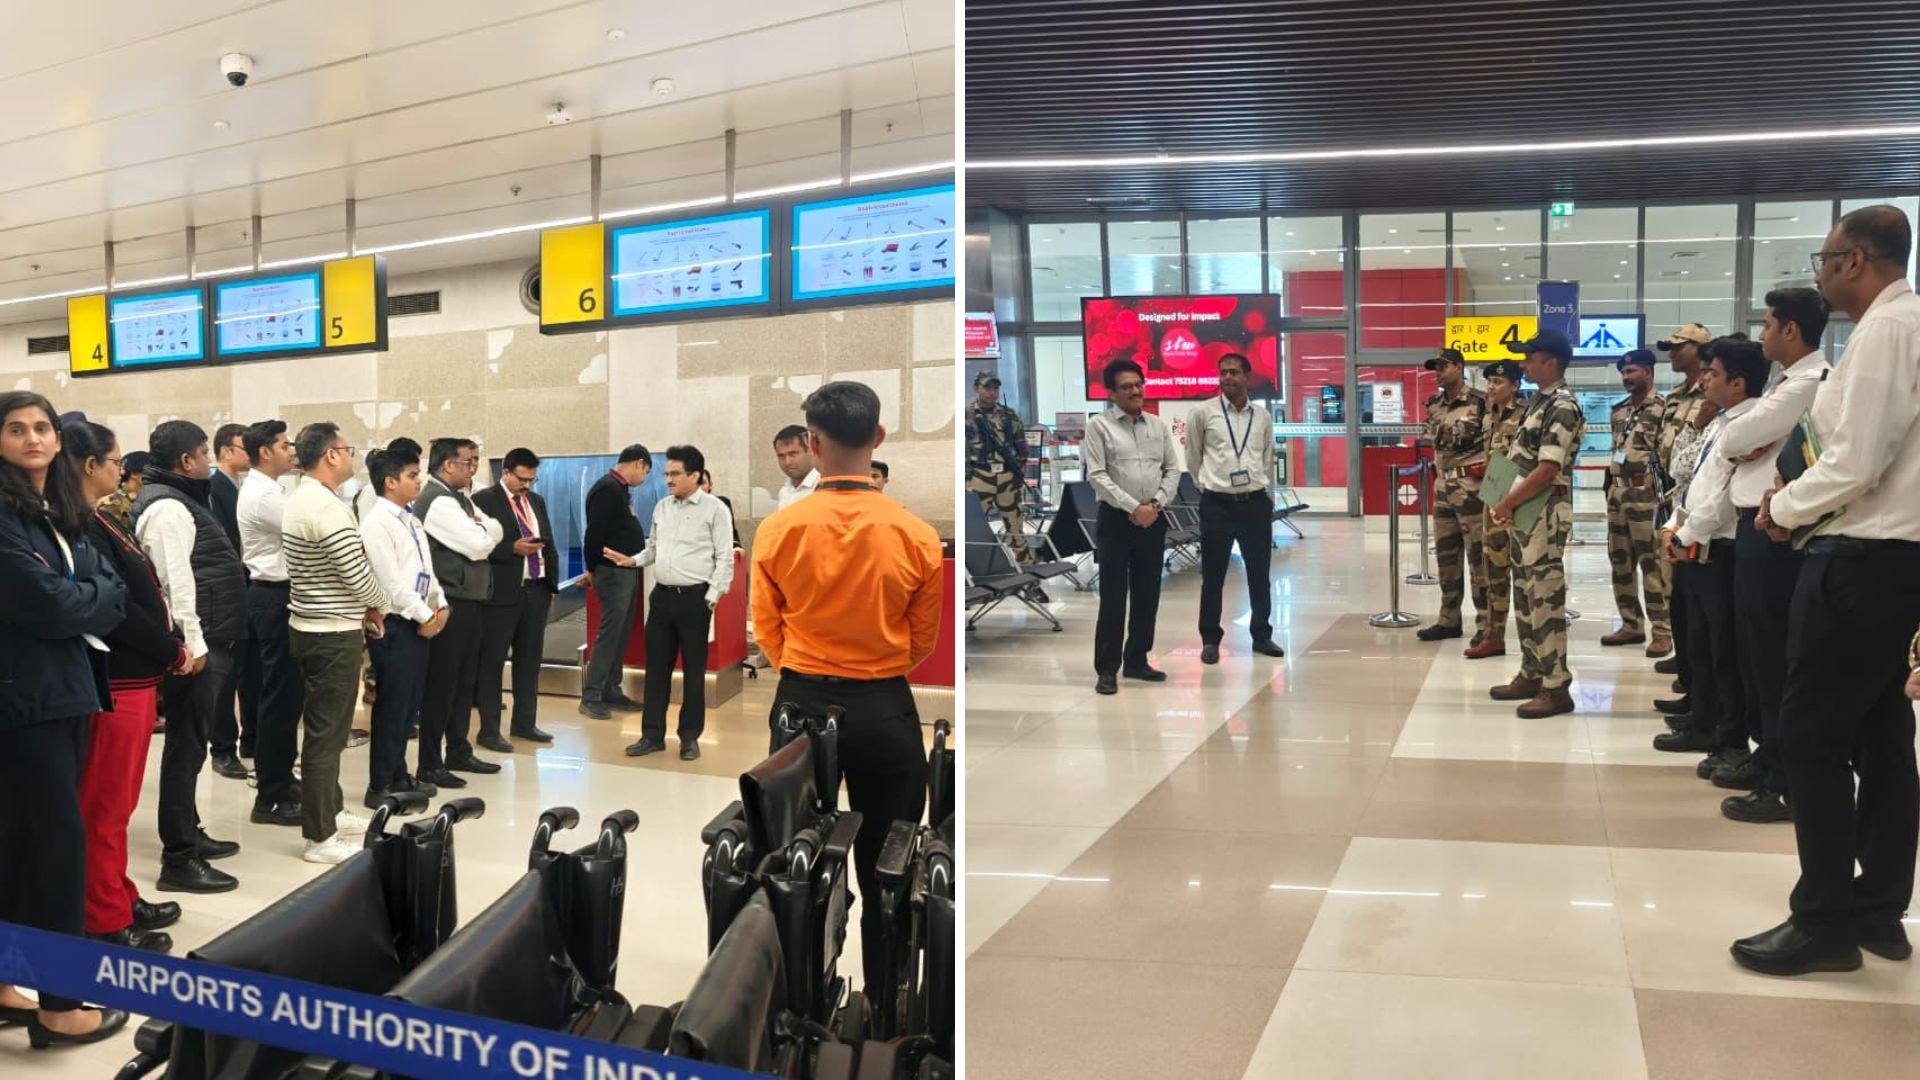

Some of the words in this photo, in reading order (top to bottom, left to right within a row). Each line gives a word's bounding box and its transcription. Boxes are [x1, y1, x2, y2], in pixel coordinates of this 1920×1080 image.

[579, 287, 596, 313] 6
[1543, 304, 1566, 314] Zone
[1566, 304, 1574, 314] 3
[331, 316, 343, 339] 5
[1138, 313, 1176, 323] Designed
[1177, 312, 1190, 321] for
[1191, 313, 1221, 323] Impact
[1499, 323, 1521, 346] 4
[92, 343, 104, 363] 4
[1451, 339, 1489, 353] Gate
[96, 955, 264, 1018] AIRPORTS
[271, 991, 499, 1067] AUTHORITY
[509, 1040, 570, 1080] OF
